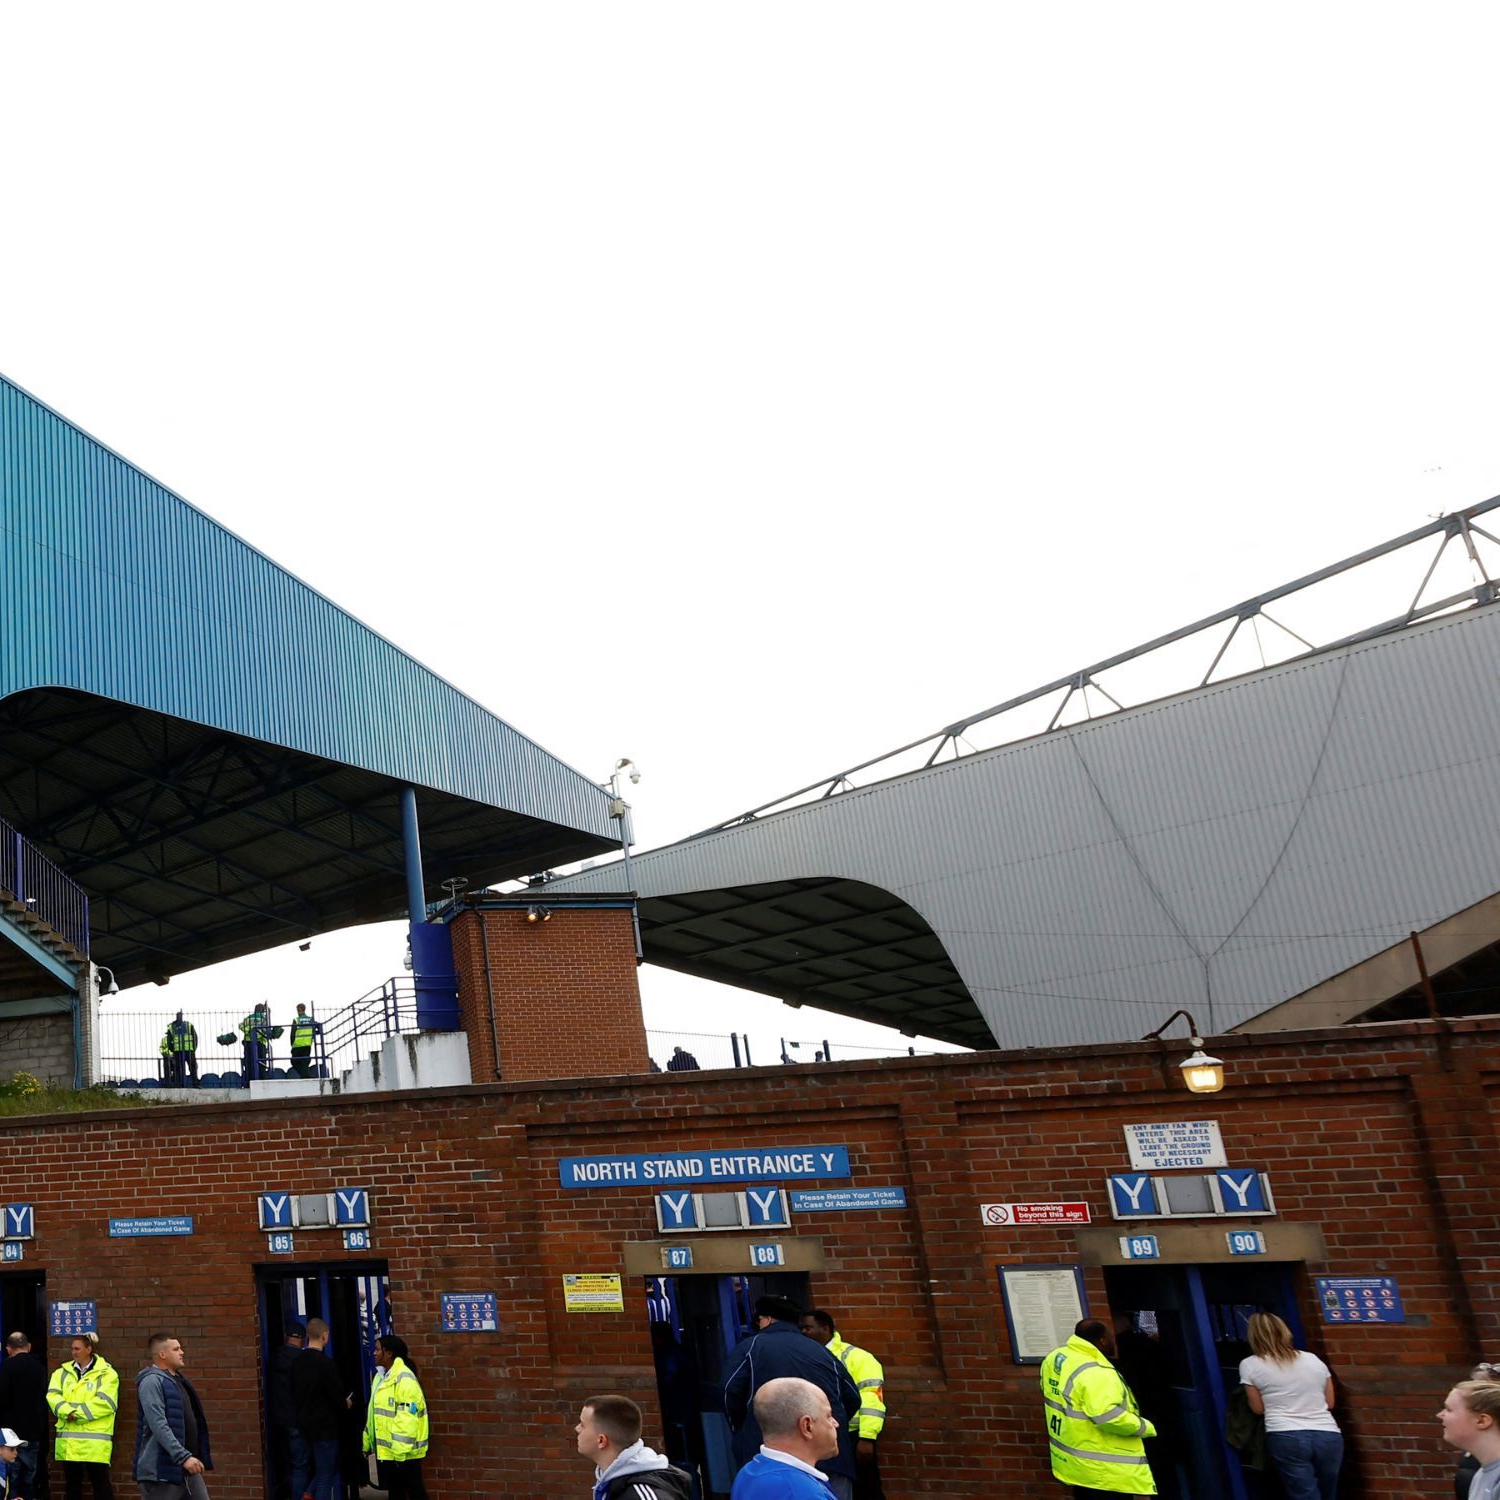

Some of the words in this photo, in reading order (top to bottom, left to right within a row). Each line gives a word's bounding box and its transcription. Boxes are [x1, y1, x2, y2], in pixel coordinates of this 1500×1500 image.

[572, 1162, 637, 1182] NORTH
[643, 1158, 703, 1179] STAND
[711, 1154, 815, 1176] ENTRANCE
[820, 1153, 834, 1172] Y
[1155, 1157, 1204, 1167] EJECTED
[1114, 1177, 1147, 1210] Y
[1220, 1174, 1253, 1207] Y
[264, 1196, 287, 1224] Y
[337, 1191, 361, 1219] Y
[662, 1194, 690, 1224] Y
[750, 1191, 777, 1221] Y
[8, 1207, 28, 1233] Y
[275, 1236, 288, 1249] 85
[350, 1233, 363, 1246] 86
[1133, 1240, 1151, 1256] 89
[1234, 1235, 1255, 1251] 90
[6, 1245, 17, 1258] 84
[672, 1251, 687, 1265] 87
[758, 1248, 774, 1263] 88
[1050, 1414, 1062, 1436] 41
